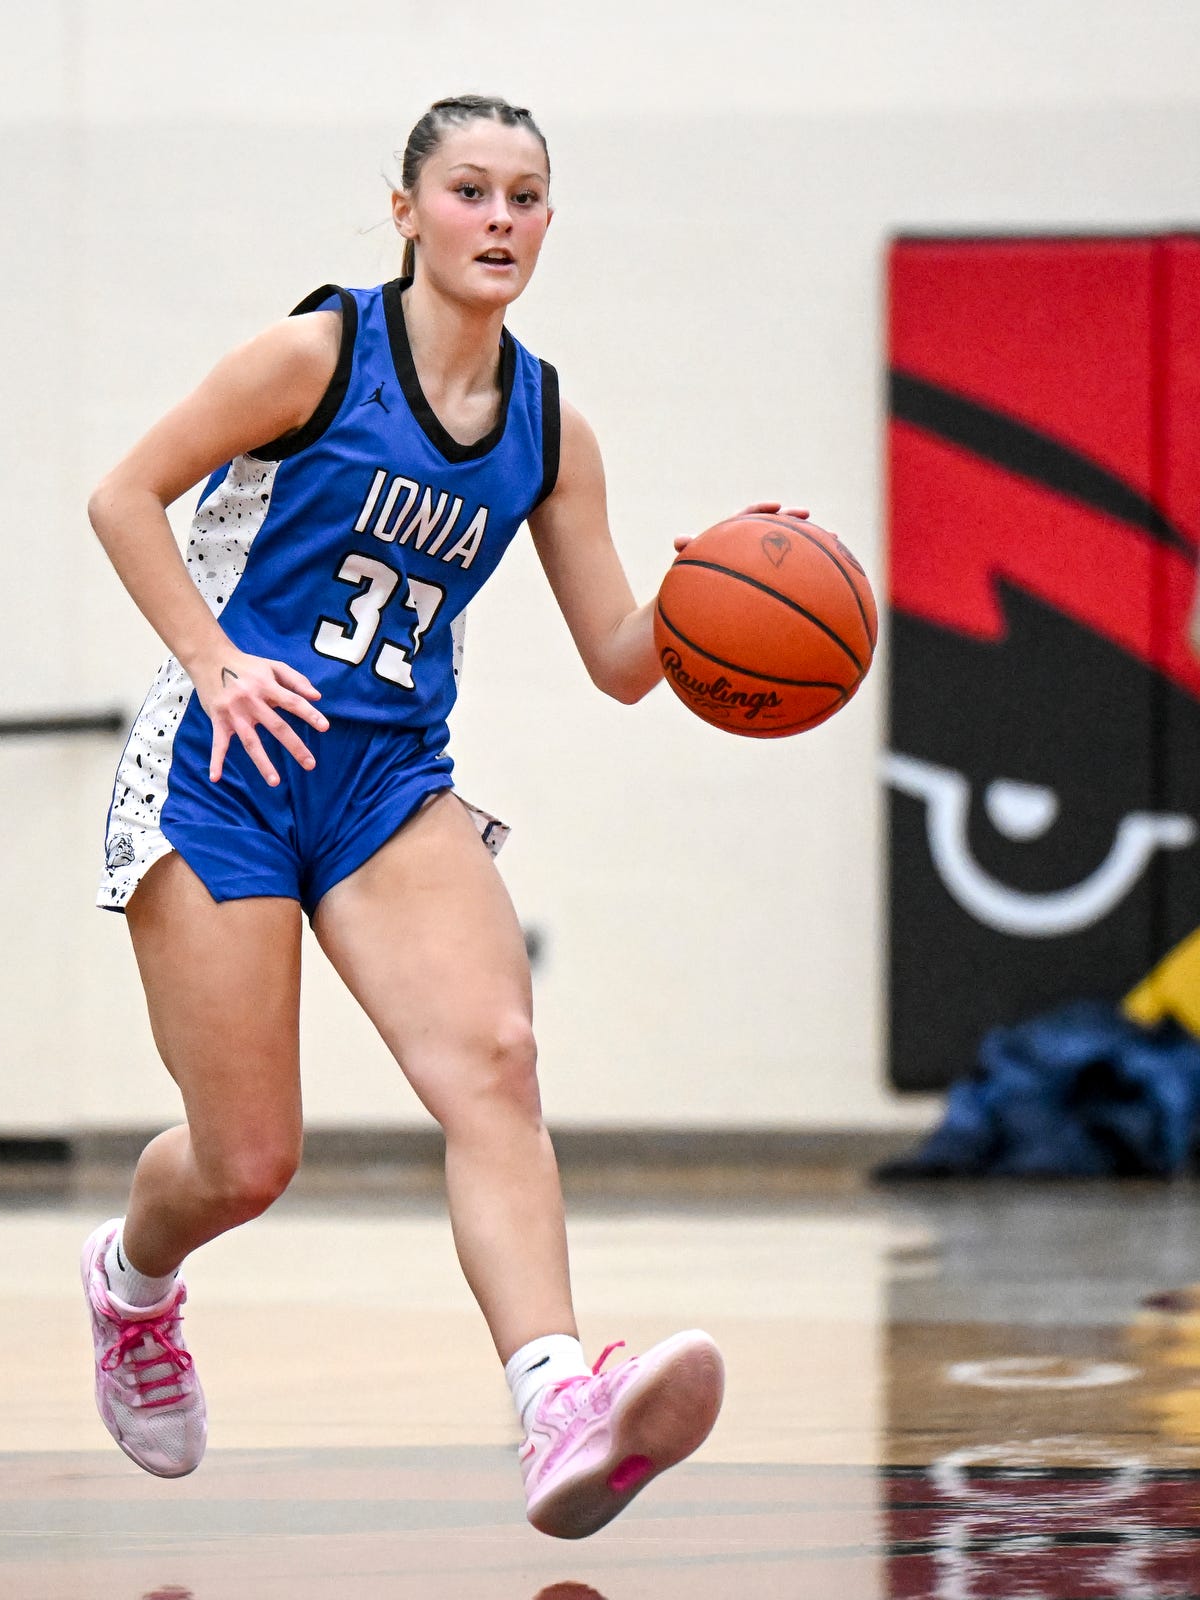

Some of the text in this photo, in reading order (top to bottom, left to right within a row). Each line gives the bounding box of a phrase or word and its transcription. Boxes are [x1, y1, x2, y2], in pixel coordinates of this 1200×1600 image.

[353, 468, 489, 570] IONIA
[311, 551, 447, 690] 33
[661, 647, 783, 720] Rawlings
